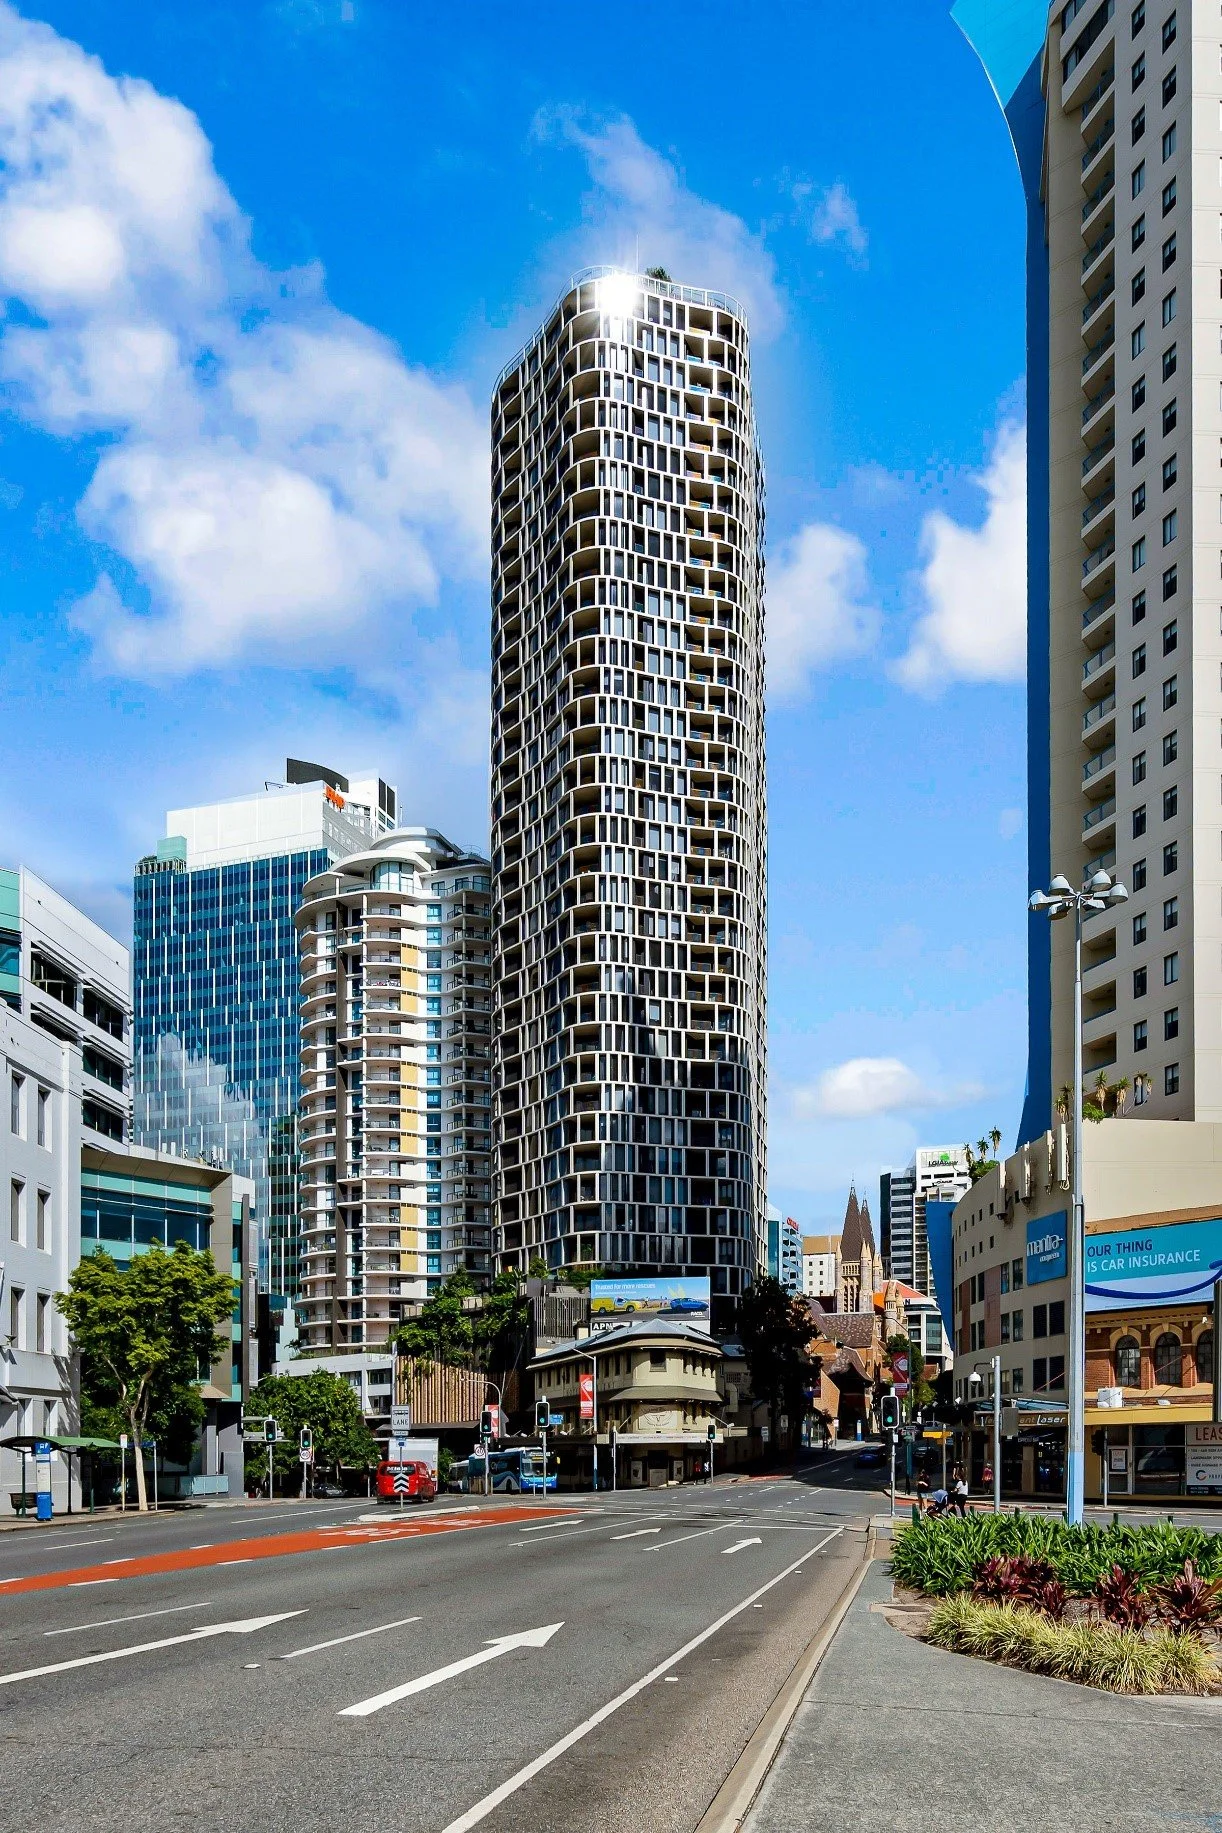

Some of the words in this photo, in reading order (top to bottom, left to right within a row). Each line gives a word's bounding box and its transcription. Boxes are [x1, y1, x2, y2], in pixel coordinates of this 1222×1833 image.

[1087, 1244, 1111, 1257] OUR
[1116, 1239, 1152, 1254] THING
[1087, 1261, 1097, 1273] IS
[1101, 1258, 1124, 1271] CAR
[1129, 1249, 1200, 1268] INSURANCE
